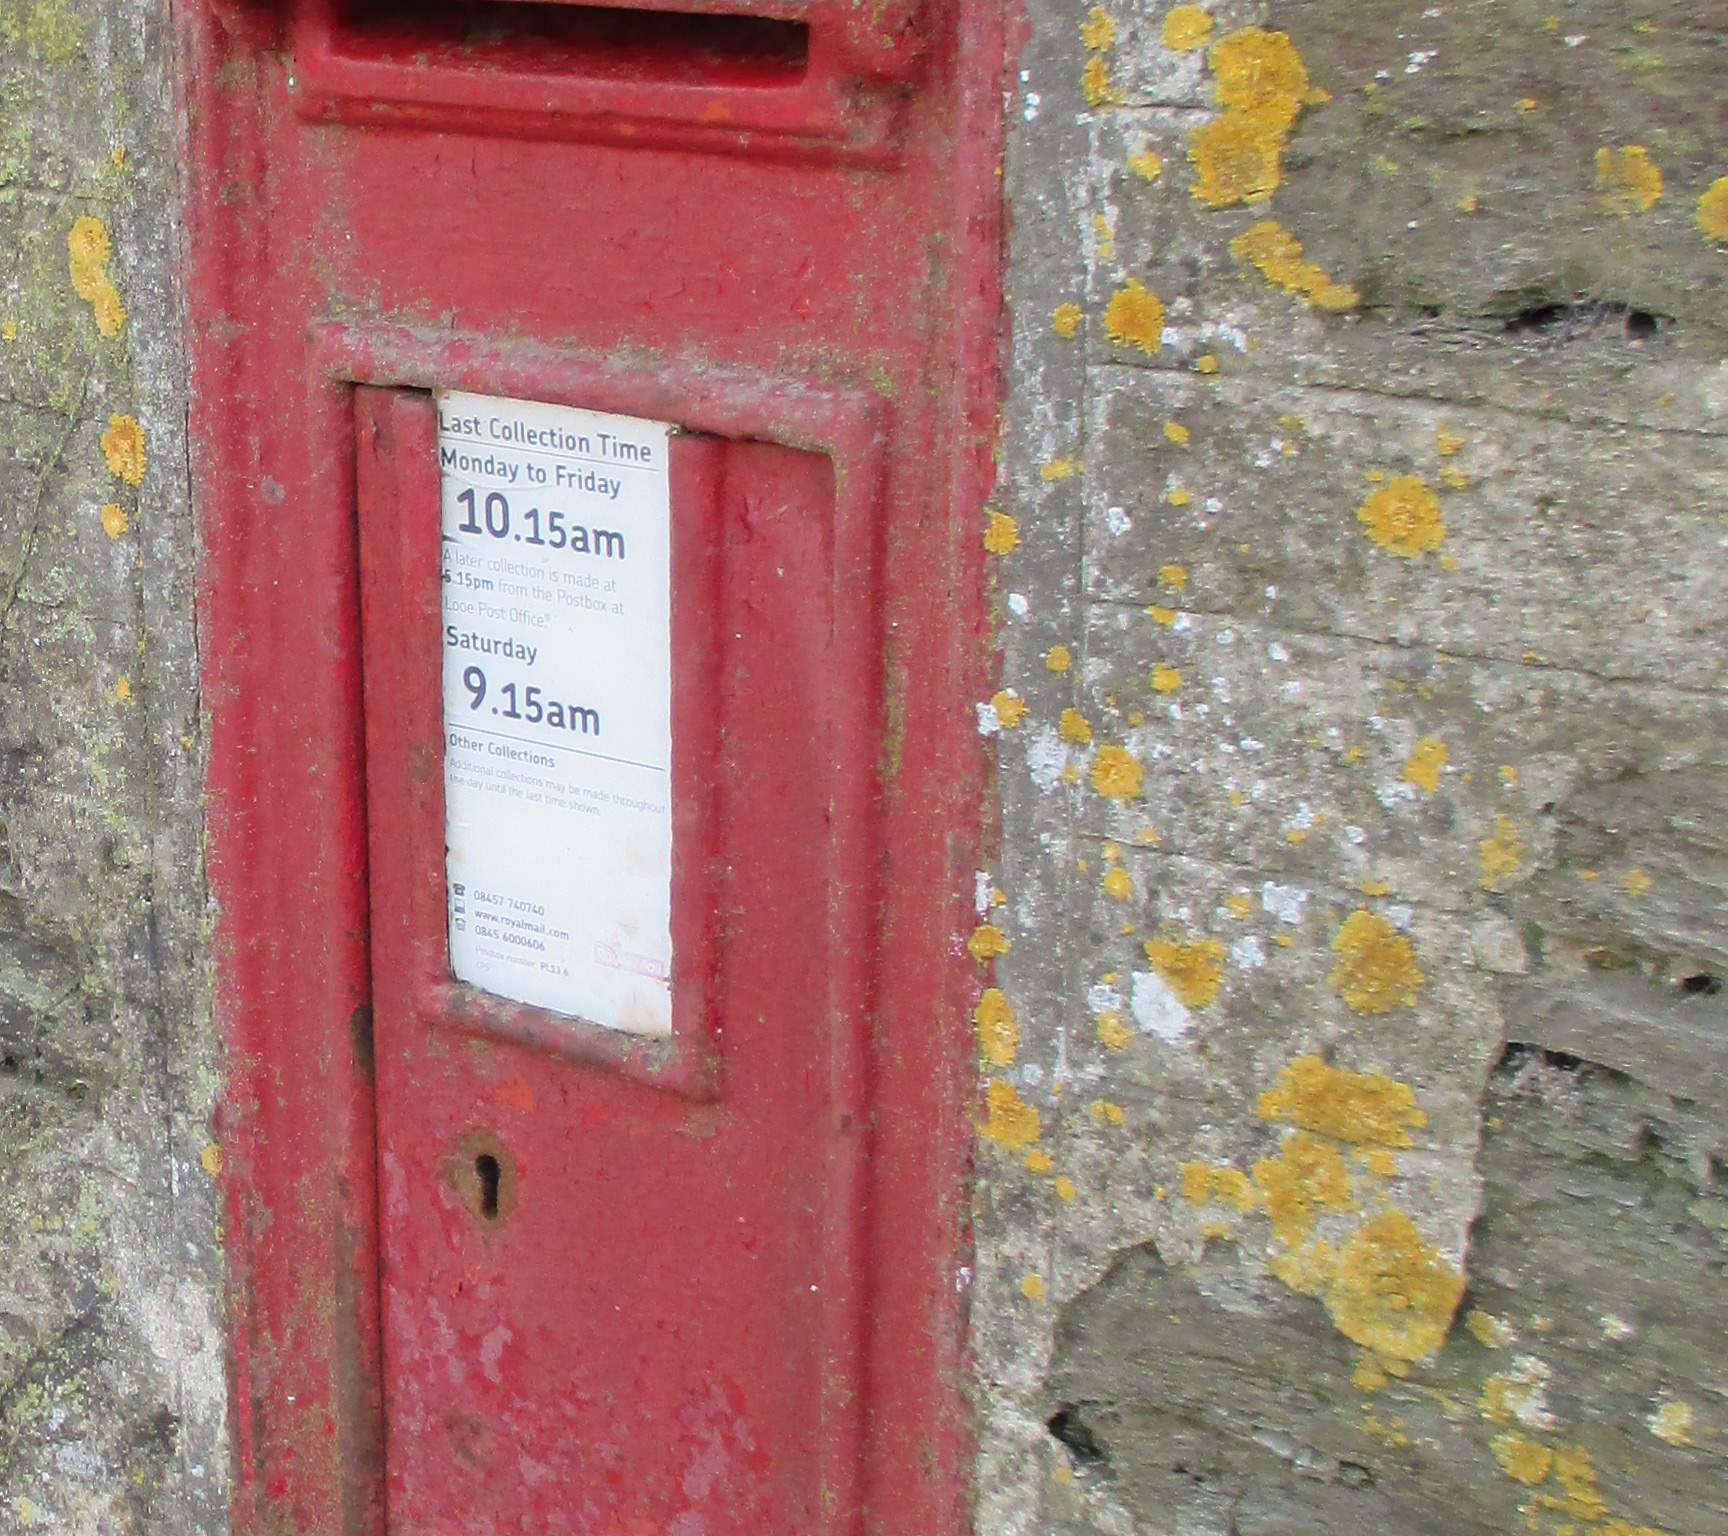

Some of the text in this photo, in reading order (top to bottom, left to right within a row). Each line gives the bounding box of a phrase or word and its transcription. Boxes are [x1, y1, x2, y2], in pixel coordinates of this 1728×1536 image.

[439, 412, 652, 462] Last Collection Time
[441, 446, 621, 499] Monday to Friday
[456, 488, 626, 560] 10.15am
[443, 547, 617, 593] A later collection is made at
[444, 596, 474, 614] Looe
[479, 602, 505, 620] Post
[498, 578, 528, 597] from
[532, 587, 553, 602] the
[557, 589, 607, 612] Postbox
[612, 602, 624, 615] at
[446, 625, 537, 666] Saturday
[463, 666, 600, 736] 9.15am
[449, 733, 555, 768] Other Collections
[485, 779, 506, 795] until
[508, 785, 523, 799] the
[526, 789, 543, 804] last
[545, 793, 566, 809] time
[496, 767, 543, 788] collections
[546, 780, 566, 794] may
[569, 783, 581, 796] be
[583, 788, 610, 803] made
[612, 795, 666, 815] throughout
[474, 890, 545, 916] 08457 740740
[475, 910, 569, 941] www.royalmail.com
[475, 925, 499, 939] 0845
